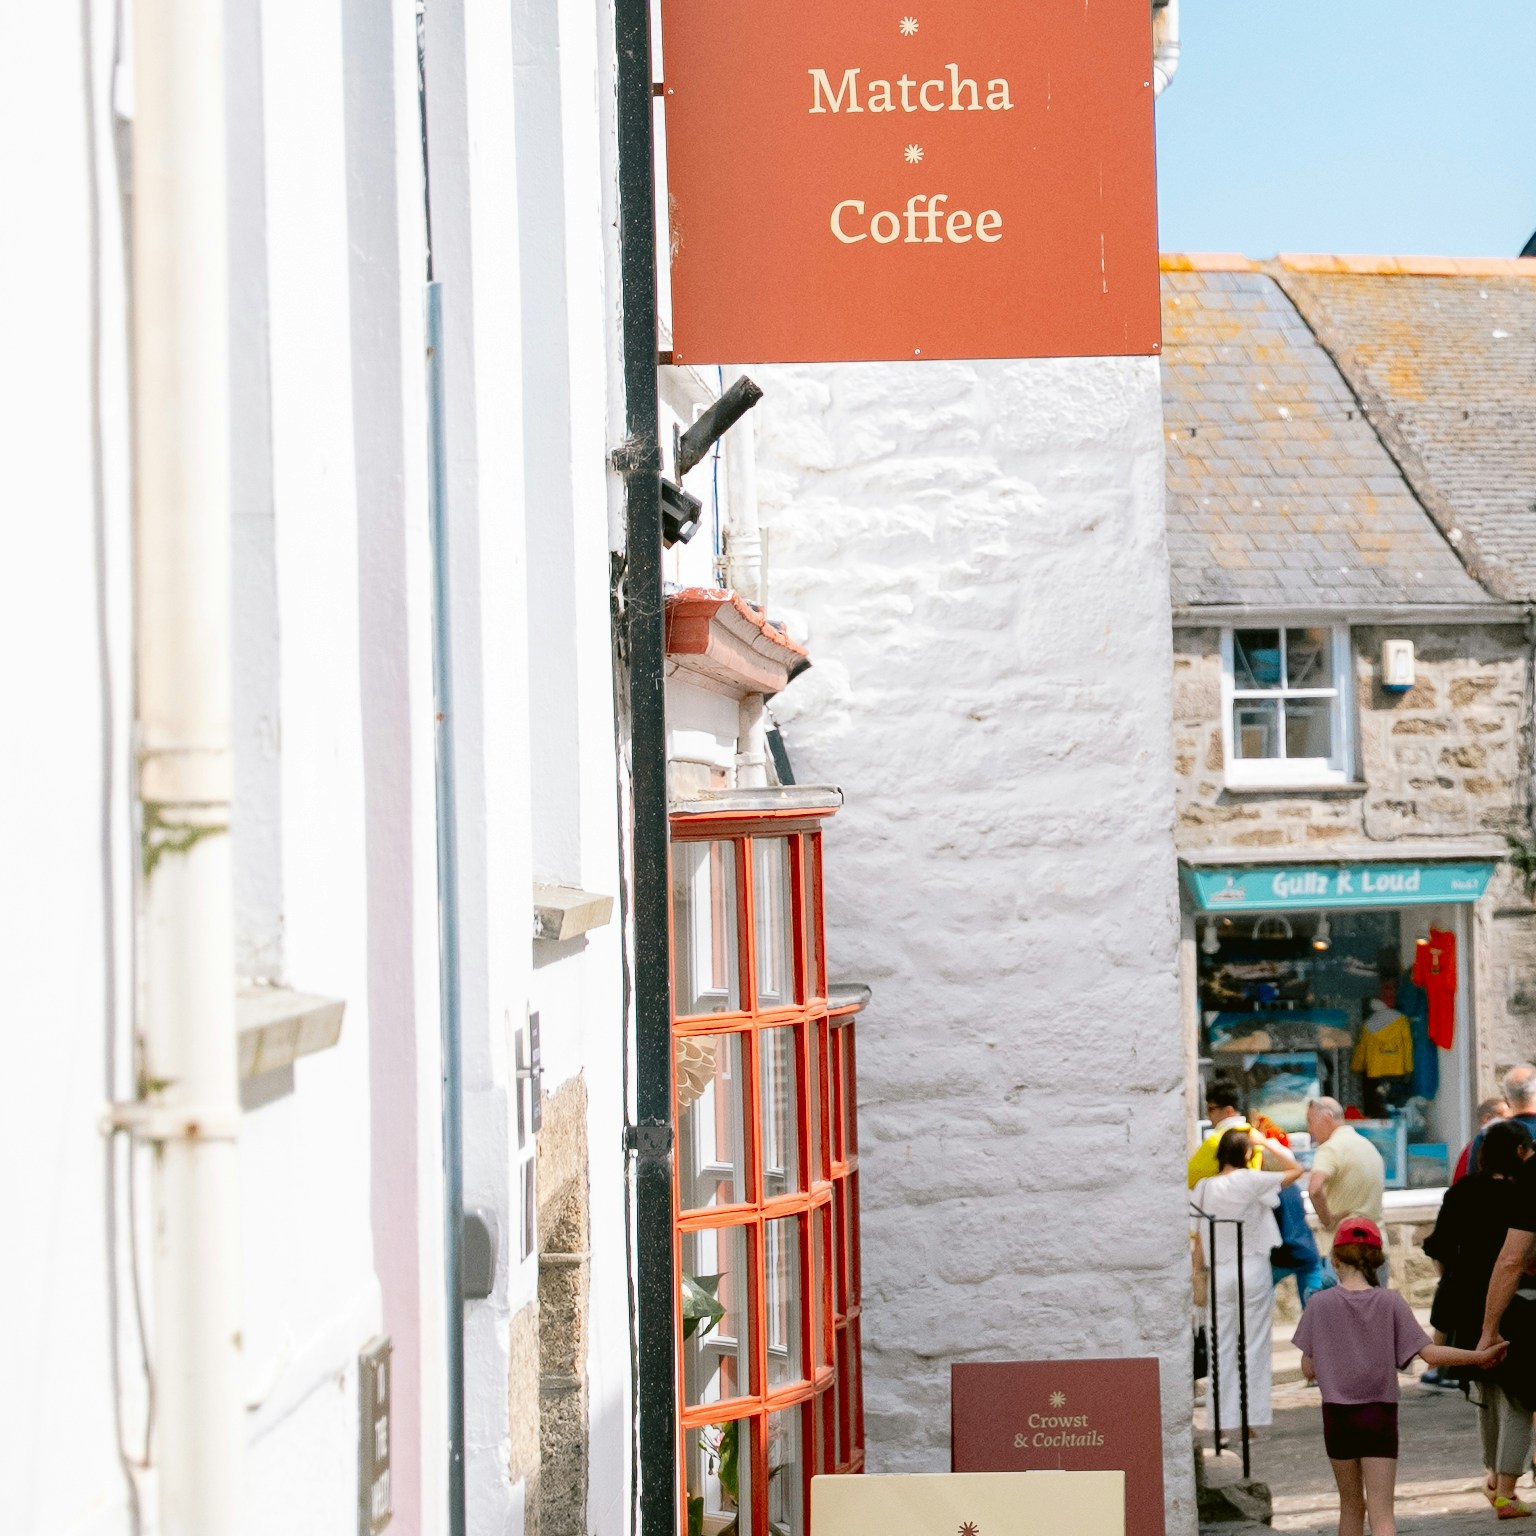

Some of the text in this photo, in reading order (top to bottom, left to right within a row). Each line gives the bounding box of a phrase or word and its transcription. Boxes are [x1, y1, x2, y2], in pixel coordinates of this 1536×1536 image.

[808, 63, 1014, 114] Matcha
[829, 194, 1004, 245] Coffee
[1361, 868, 1421, 894] Loud
[1028, 1413, 1089, 1429] Crowst
[1013, 1430, 1105, 1448] & Cocktails
